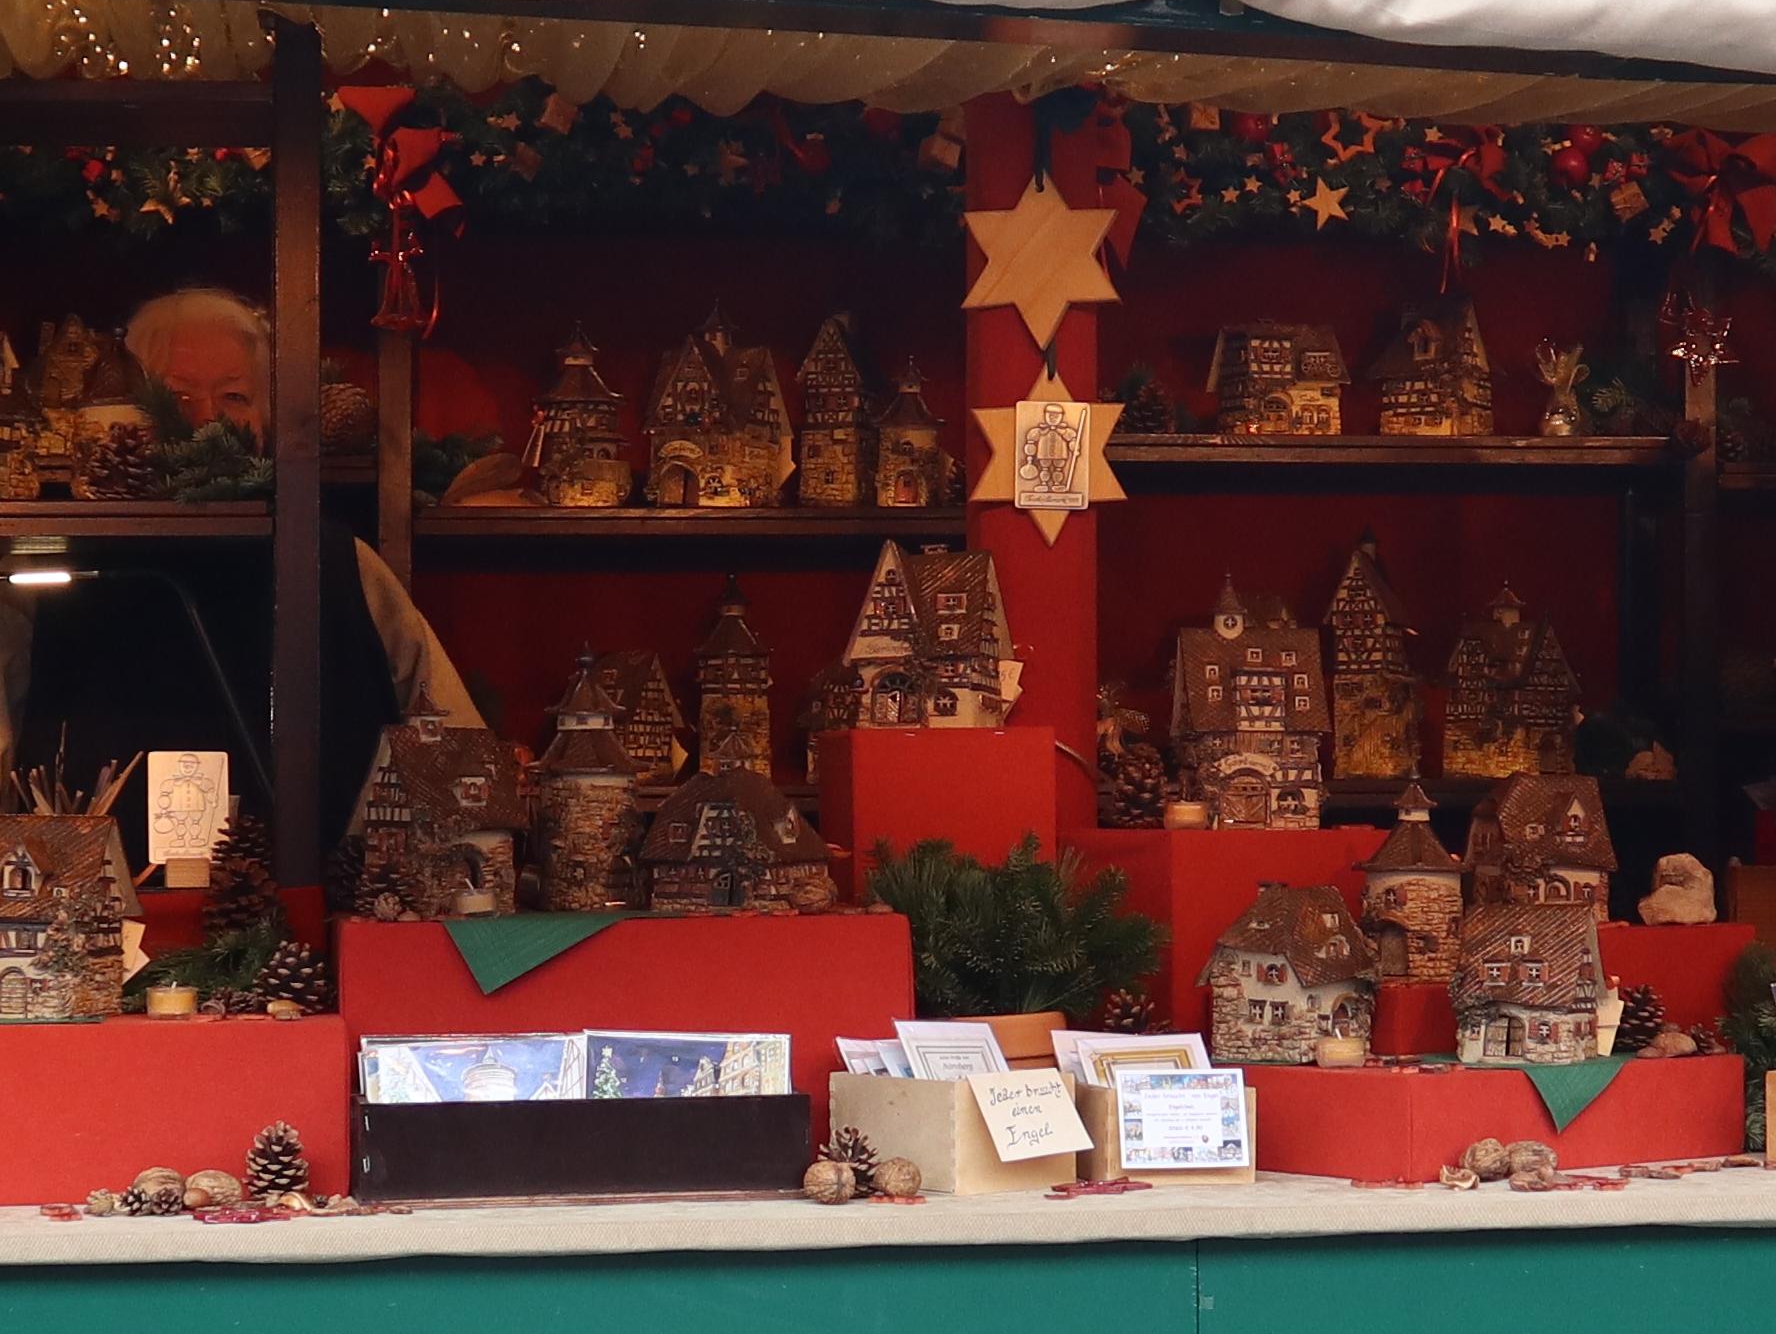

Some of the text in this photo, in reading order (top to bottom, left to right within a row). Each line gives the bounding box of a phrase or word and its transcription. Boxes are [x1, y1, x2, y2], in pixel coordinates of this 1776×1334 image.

[989, 1086, 1023, 1106] Jeder
[1011, 1101, 1043, 1117] einen
[1005, 1122, 1054, 1148] Engel
